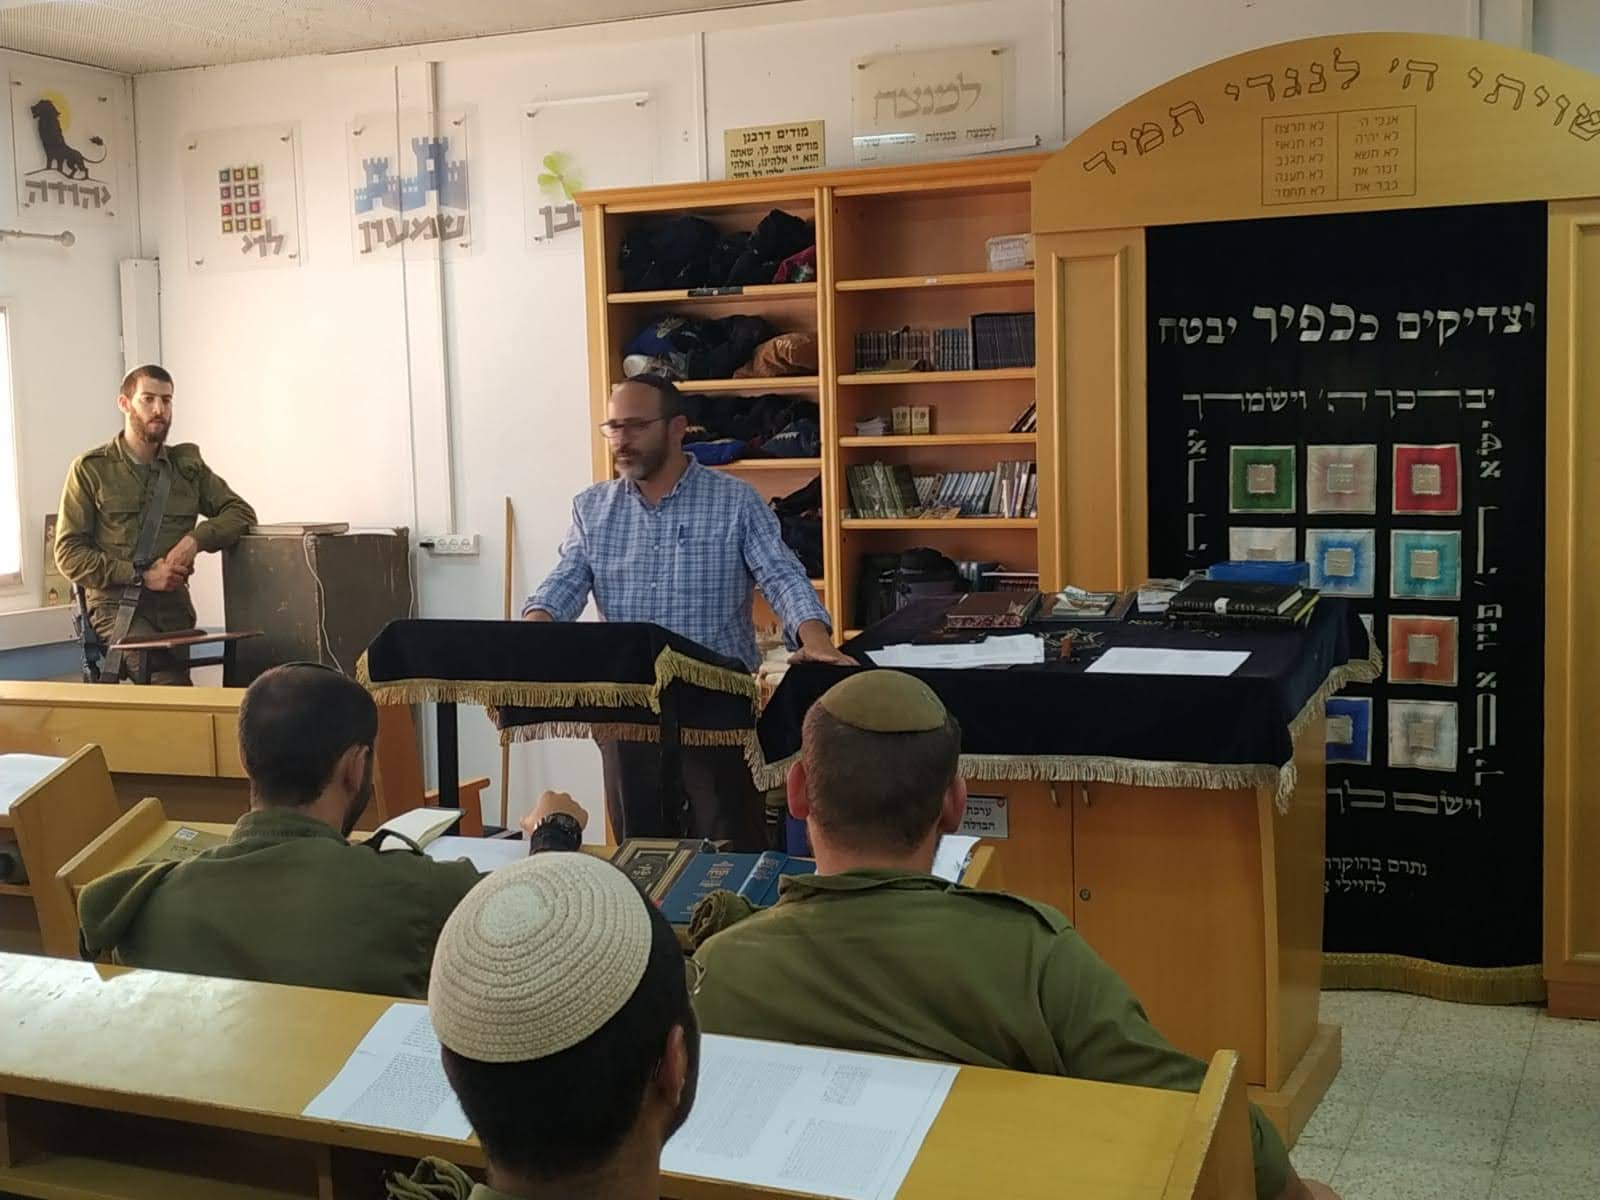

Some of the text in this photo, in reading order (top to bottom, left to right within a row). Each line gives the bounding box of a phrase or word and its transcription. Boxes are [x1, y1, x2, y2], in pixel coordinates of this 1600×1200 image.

[1223, 48, 1360, 101] לנגדי
[1275, 119, 1325, 135] לא תרצח
[743, 127, 809, 144] מודים דרבנן
[1083, 101, 1204, 175] תמיד
[1310, 135, 1324, 148] לא
[1354, 128, 1399, 144] לא יהיה
[730, 147, 754, 158] שאתה
[772, 144, 792, 153] אנחנו
[796, 141, 819, 151] מודים
[1354, 145, 1399, 160] לא תשא
[731, 158, 754, 169] ואלהי
[803, 153, 819, 163] הוא
[1309, 152, 1324, 164] לא
[1309, 168, 1324, 180] לא
[1353, 163, 1398, 177] זכור את
[25, 180, 111, 209] יהודה
[1310, 184, 1325, 196] לא
[1354, 183, 1370, 193] את
[241, 219, 284, 257] לוי
[358, 213, 465, 254] שמעון
[1158, 315, 1238, 345] יבטח
[1397, 302, 1536, 348] וצדיקים
[1183, 386, 1306, 421] וישמרך
[1374, 388, 1496, 419] יברכך
[1392, 790, 1482, 819] וישם
[1387, 858, 1428, 877] נתרם
[1335, 873, 1387, 894] לחיילי
